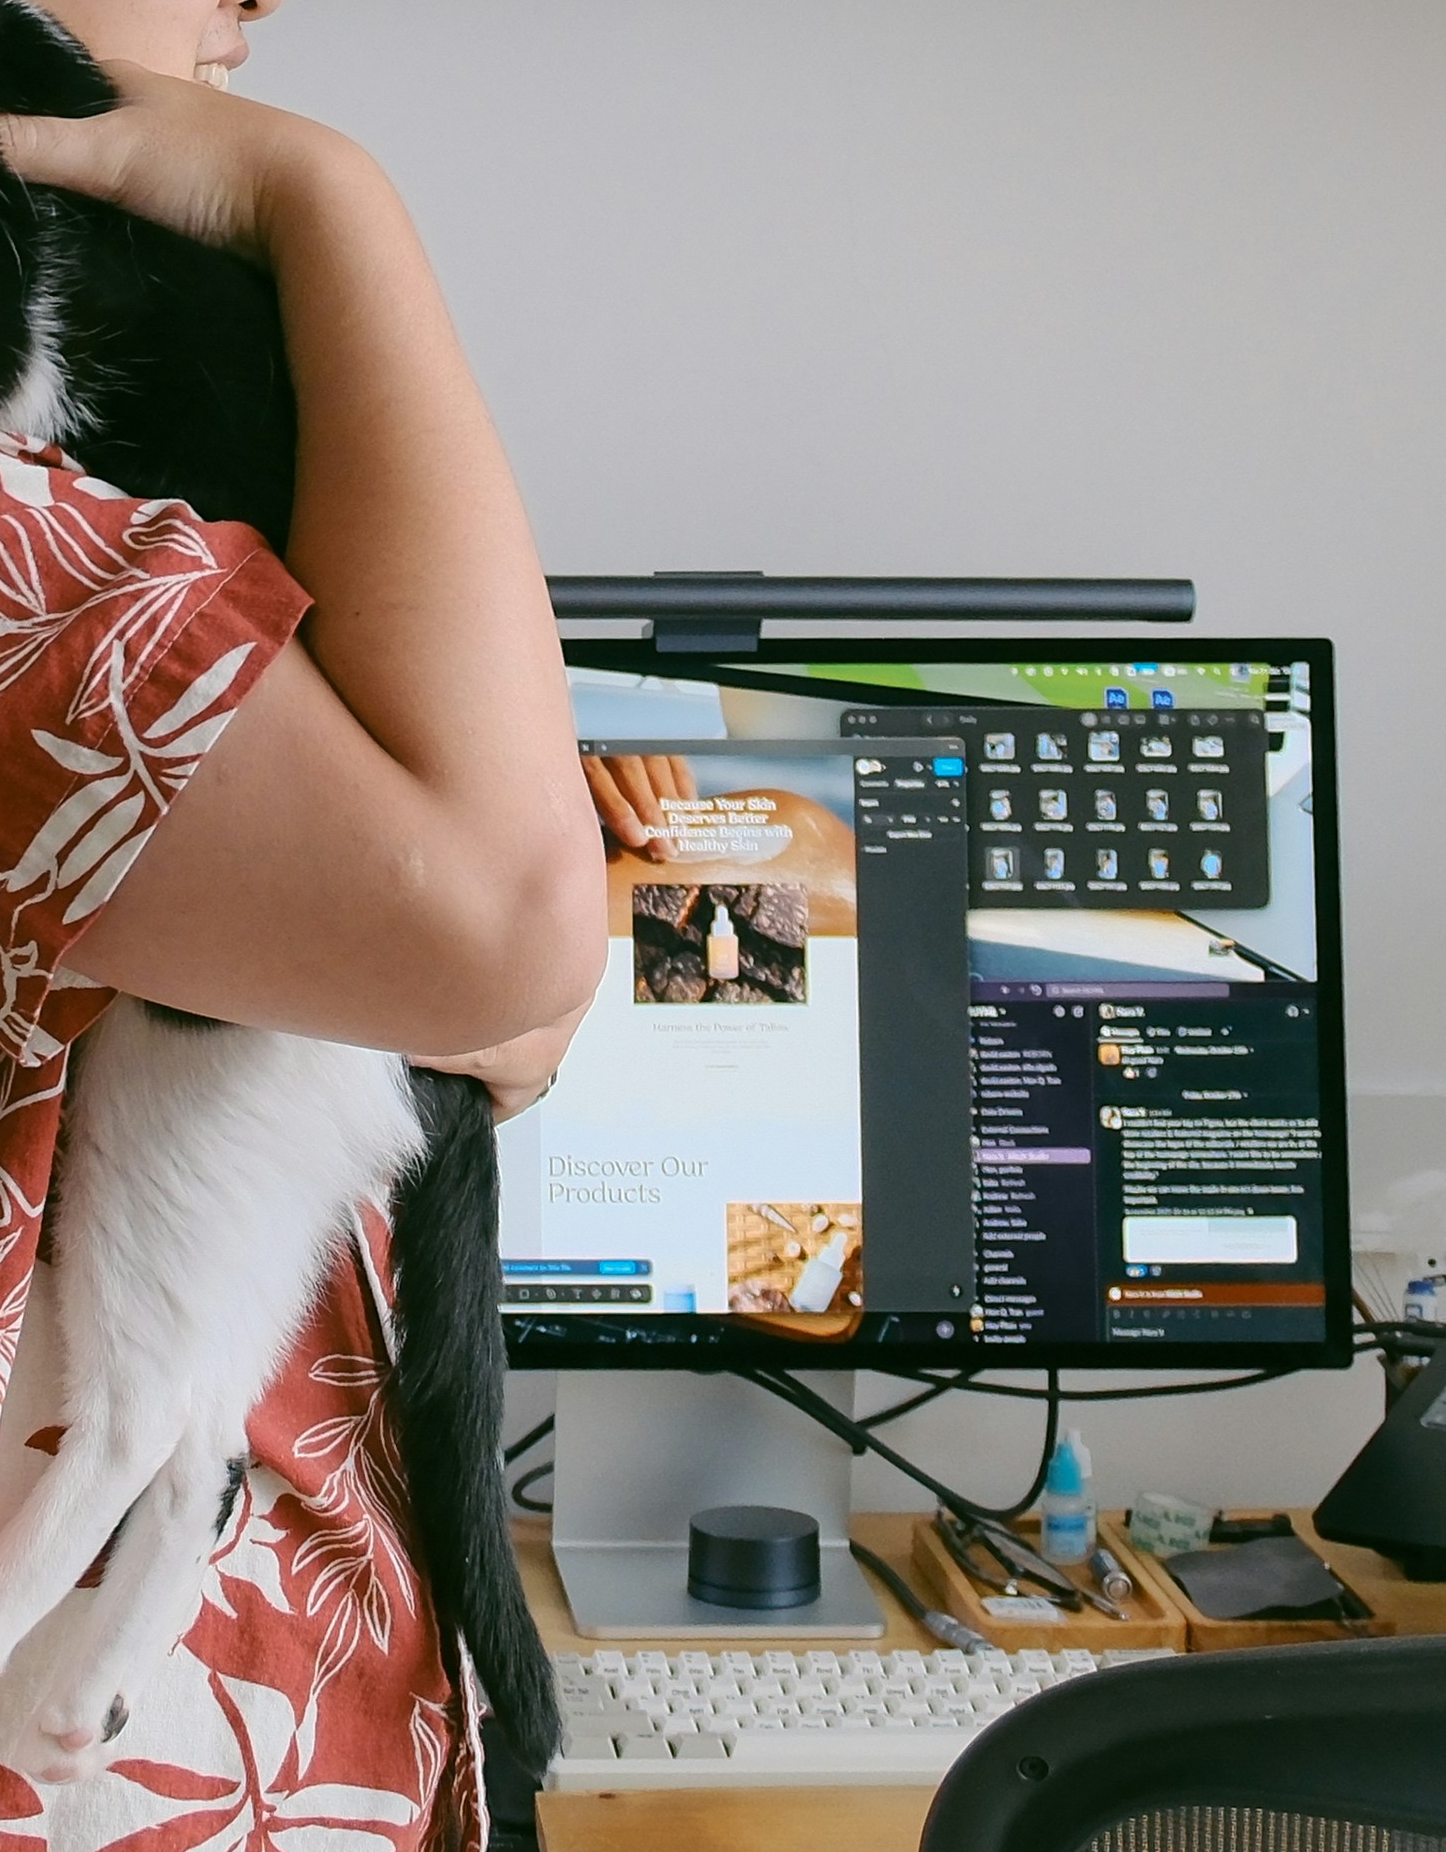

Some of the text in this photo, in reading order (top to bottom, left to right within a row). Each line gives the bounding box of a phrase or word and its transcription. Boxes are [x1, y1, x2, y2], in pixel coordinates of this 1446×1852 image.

[660, 797, 777, 811] Because Your Skin
[668, 812, 769, 825] Deserves Better
[645, 825, 793, 841] Confidence Begins with
[678, 839, 759, 853] Healthy Skin
[653, 1023, 755, 1032] Harness the Power of
[548, 1156, 709, 1178] Discover Our
[548, 1182, 662, 1205] Products
